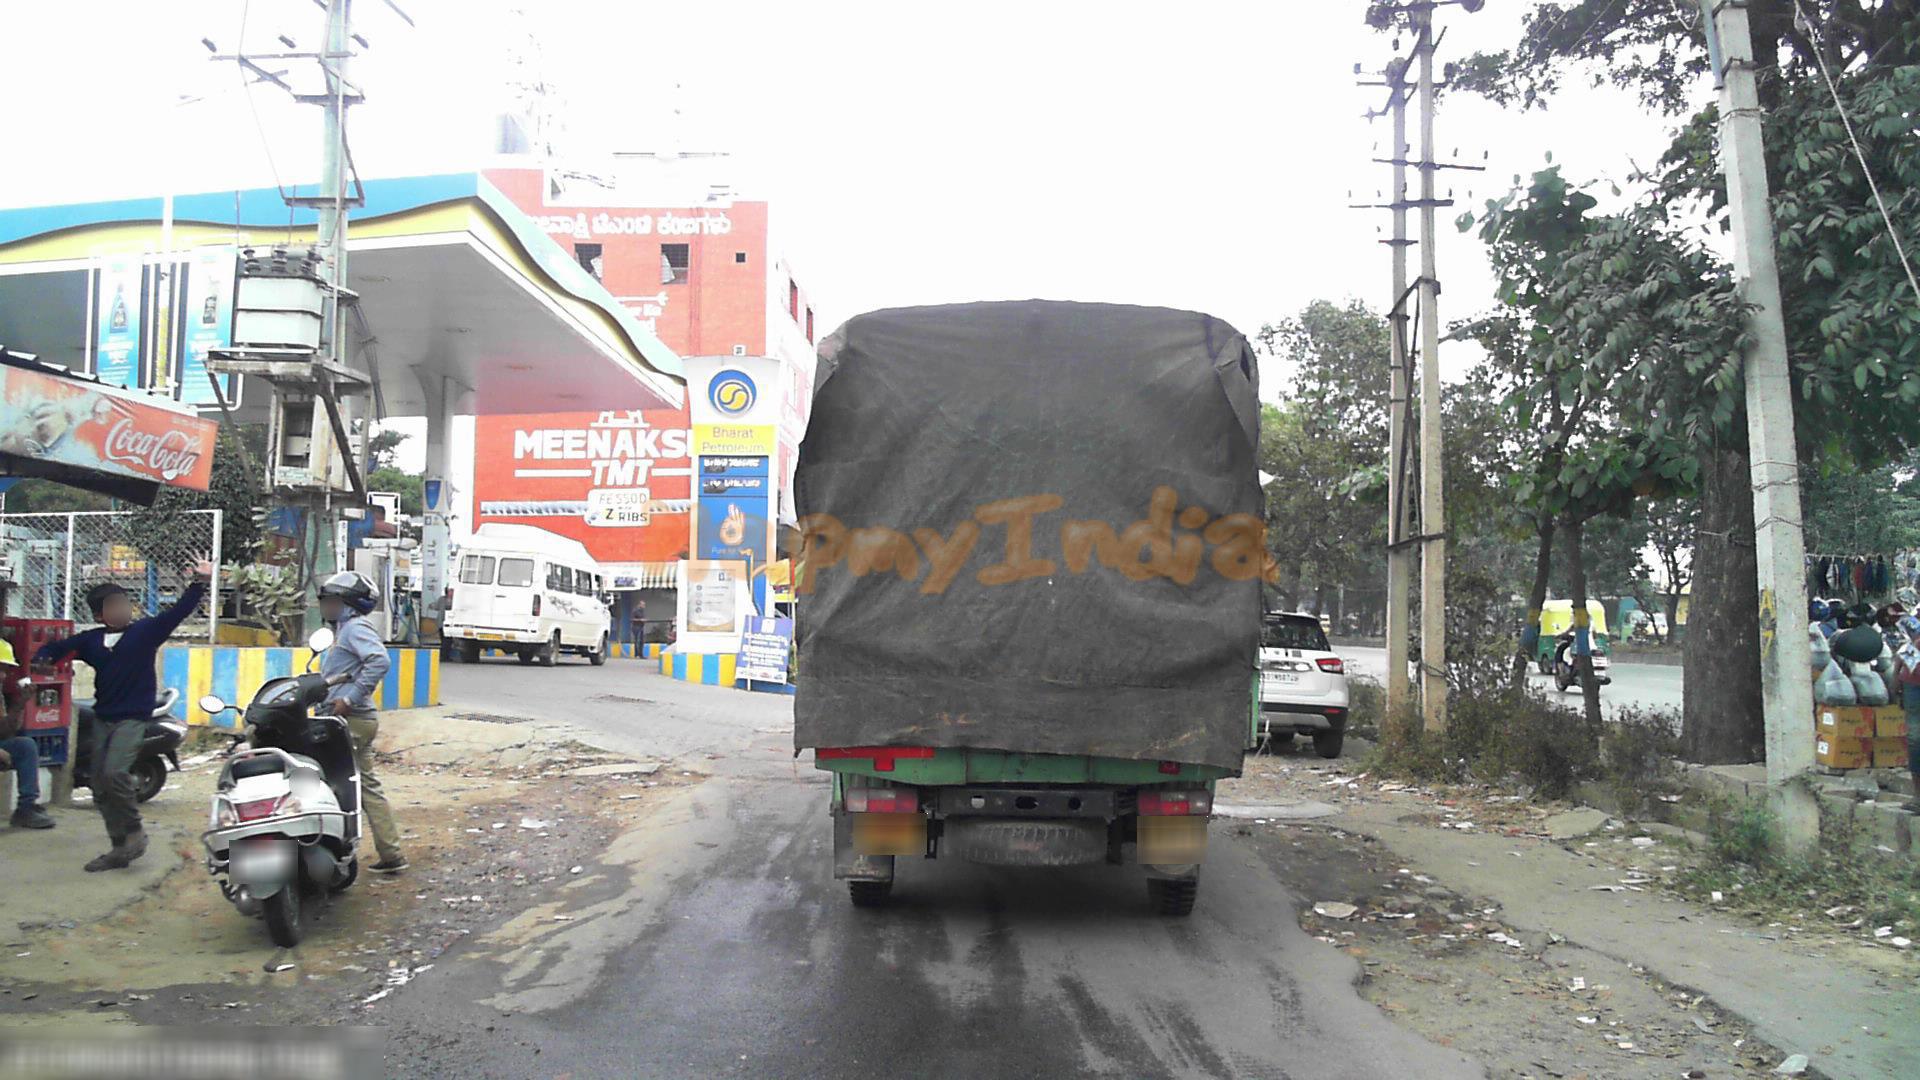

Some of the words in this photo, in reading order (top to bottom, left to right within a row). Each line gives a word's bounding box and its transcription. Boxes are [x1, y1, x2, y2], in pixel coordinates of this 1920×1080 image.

[712, 426, 754, 439] Bharat
[702, 441, 764, 453] Petroleum
[591, 460, 654, 486] TMT
[605, 507, 614, 520] Z
[618, 511, 648, 522] RIBS
